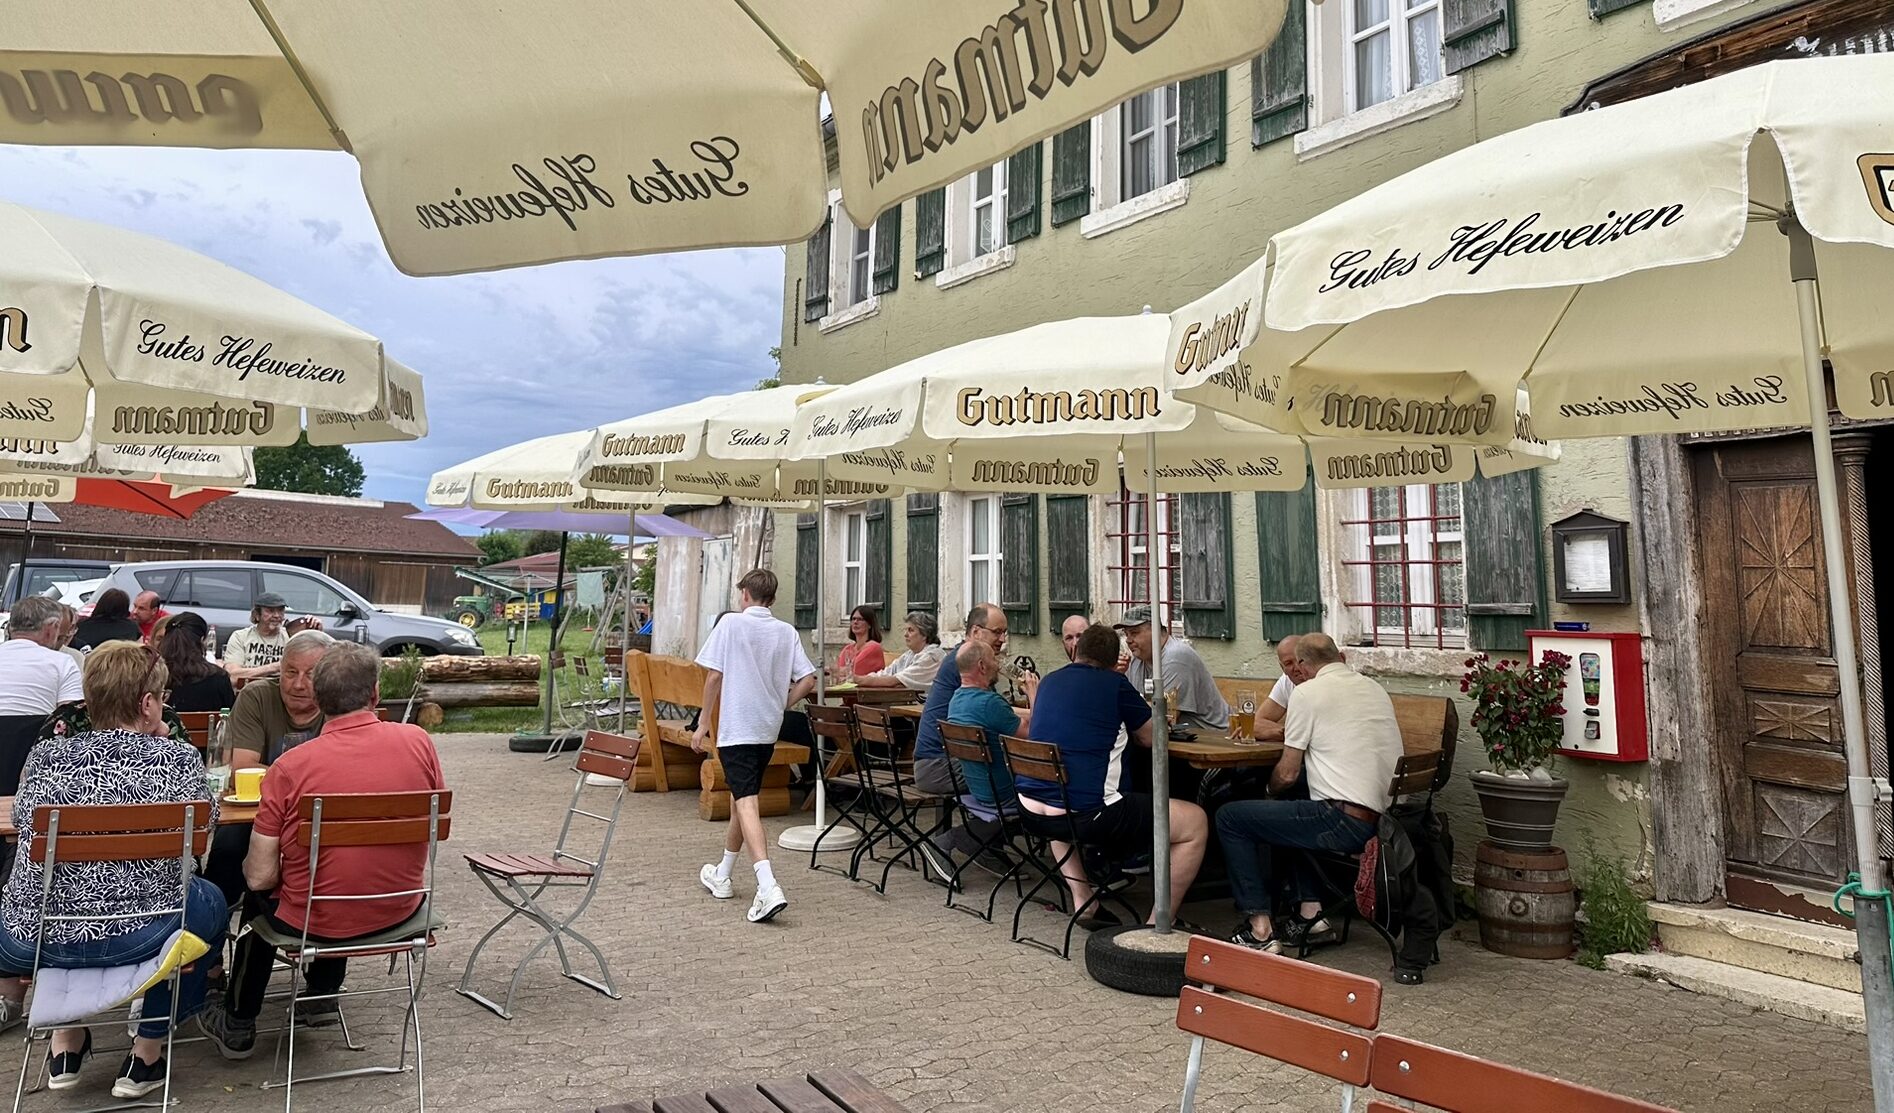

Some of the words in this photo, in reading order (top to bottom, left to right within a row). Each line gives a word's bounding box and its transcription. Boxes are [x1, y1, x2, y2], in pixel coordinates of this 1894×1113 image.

[1318, 248, 1420, 294] Gutes
[1428, 202, 1685, 276] Hefeweizen
[137, 319, 205, 362] Gutes
[212, 335, 346, 385] Hefeweizen
[957, 386, 1162, 426] Gutmann
[602, 432, 686, 457] Gutmann
[728, 428, 770, 446] Gutes
[149, 444, 221, 464] Hefeweizen
[486, 478, 574, 499] Gutmann
